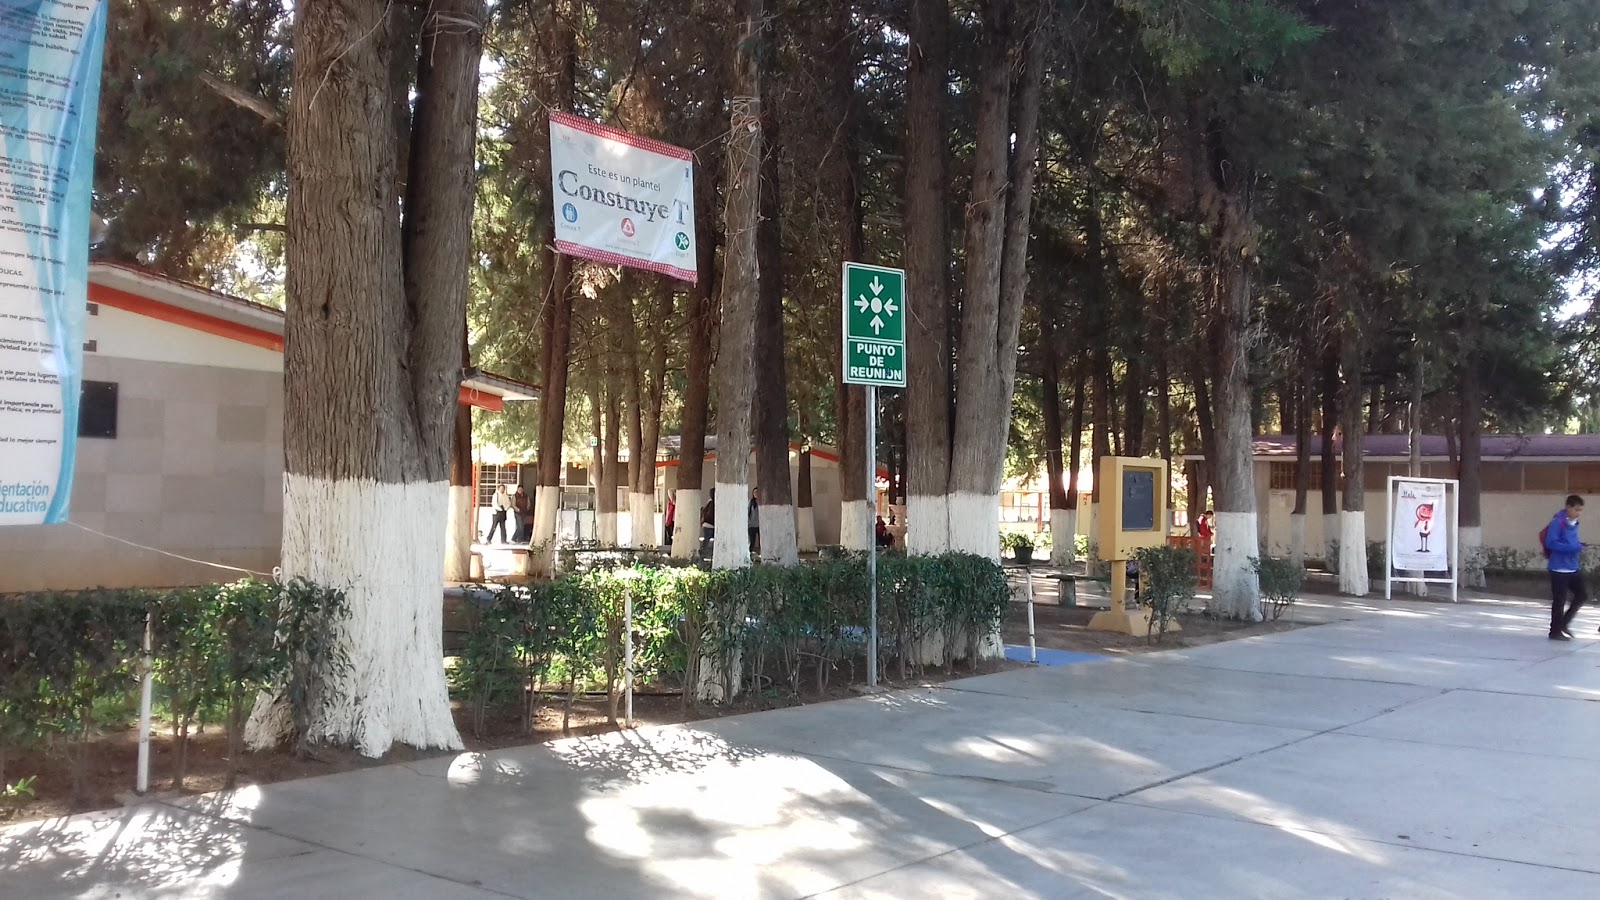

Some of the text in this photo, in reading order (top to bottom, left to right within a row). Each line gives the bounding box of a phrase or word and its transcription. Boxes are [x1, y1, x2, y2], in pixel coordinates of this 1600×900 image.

[588, 163, 661, 192] Este es un plantel
[557, 169, 689, 225] Construye T
[1, 219, 24, 227] cultura
[857, 343, 896, 356] PUNTO
[869, 355, 885, 367] DE
[0, 480, 50, 497] entación
